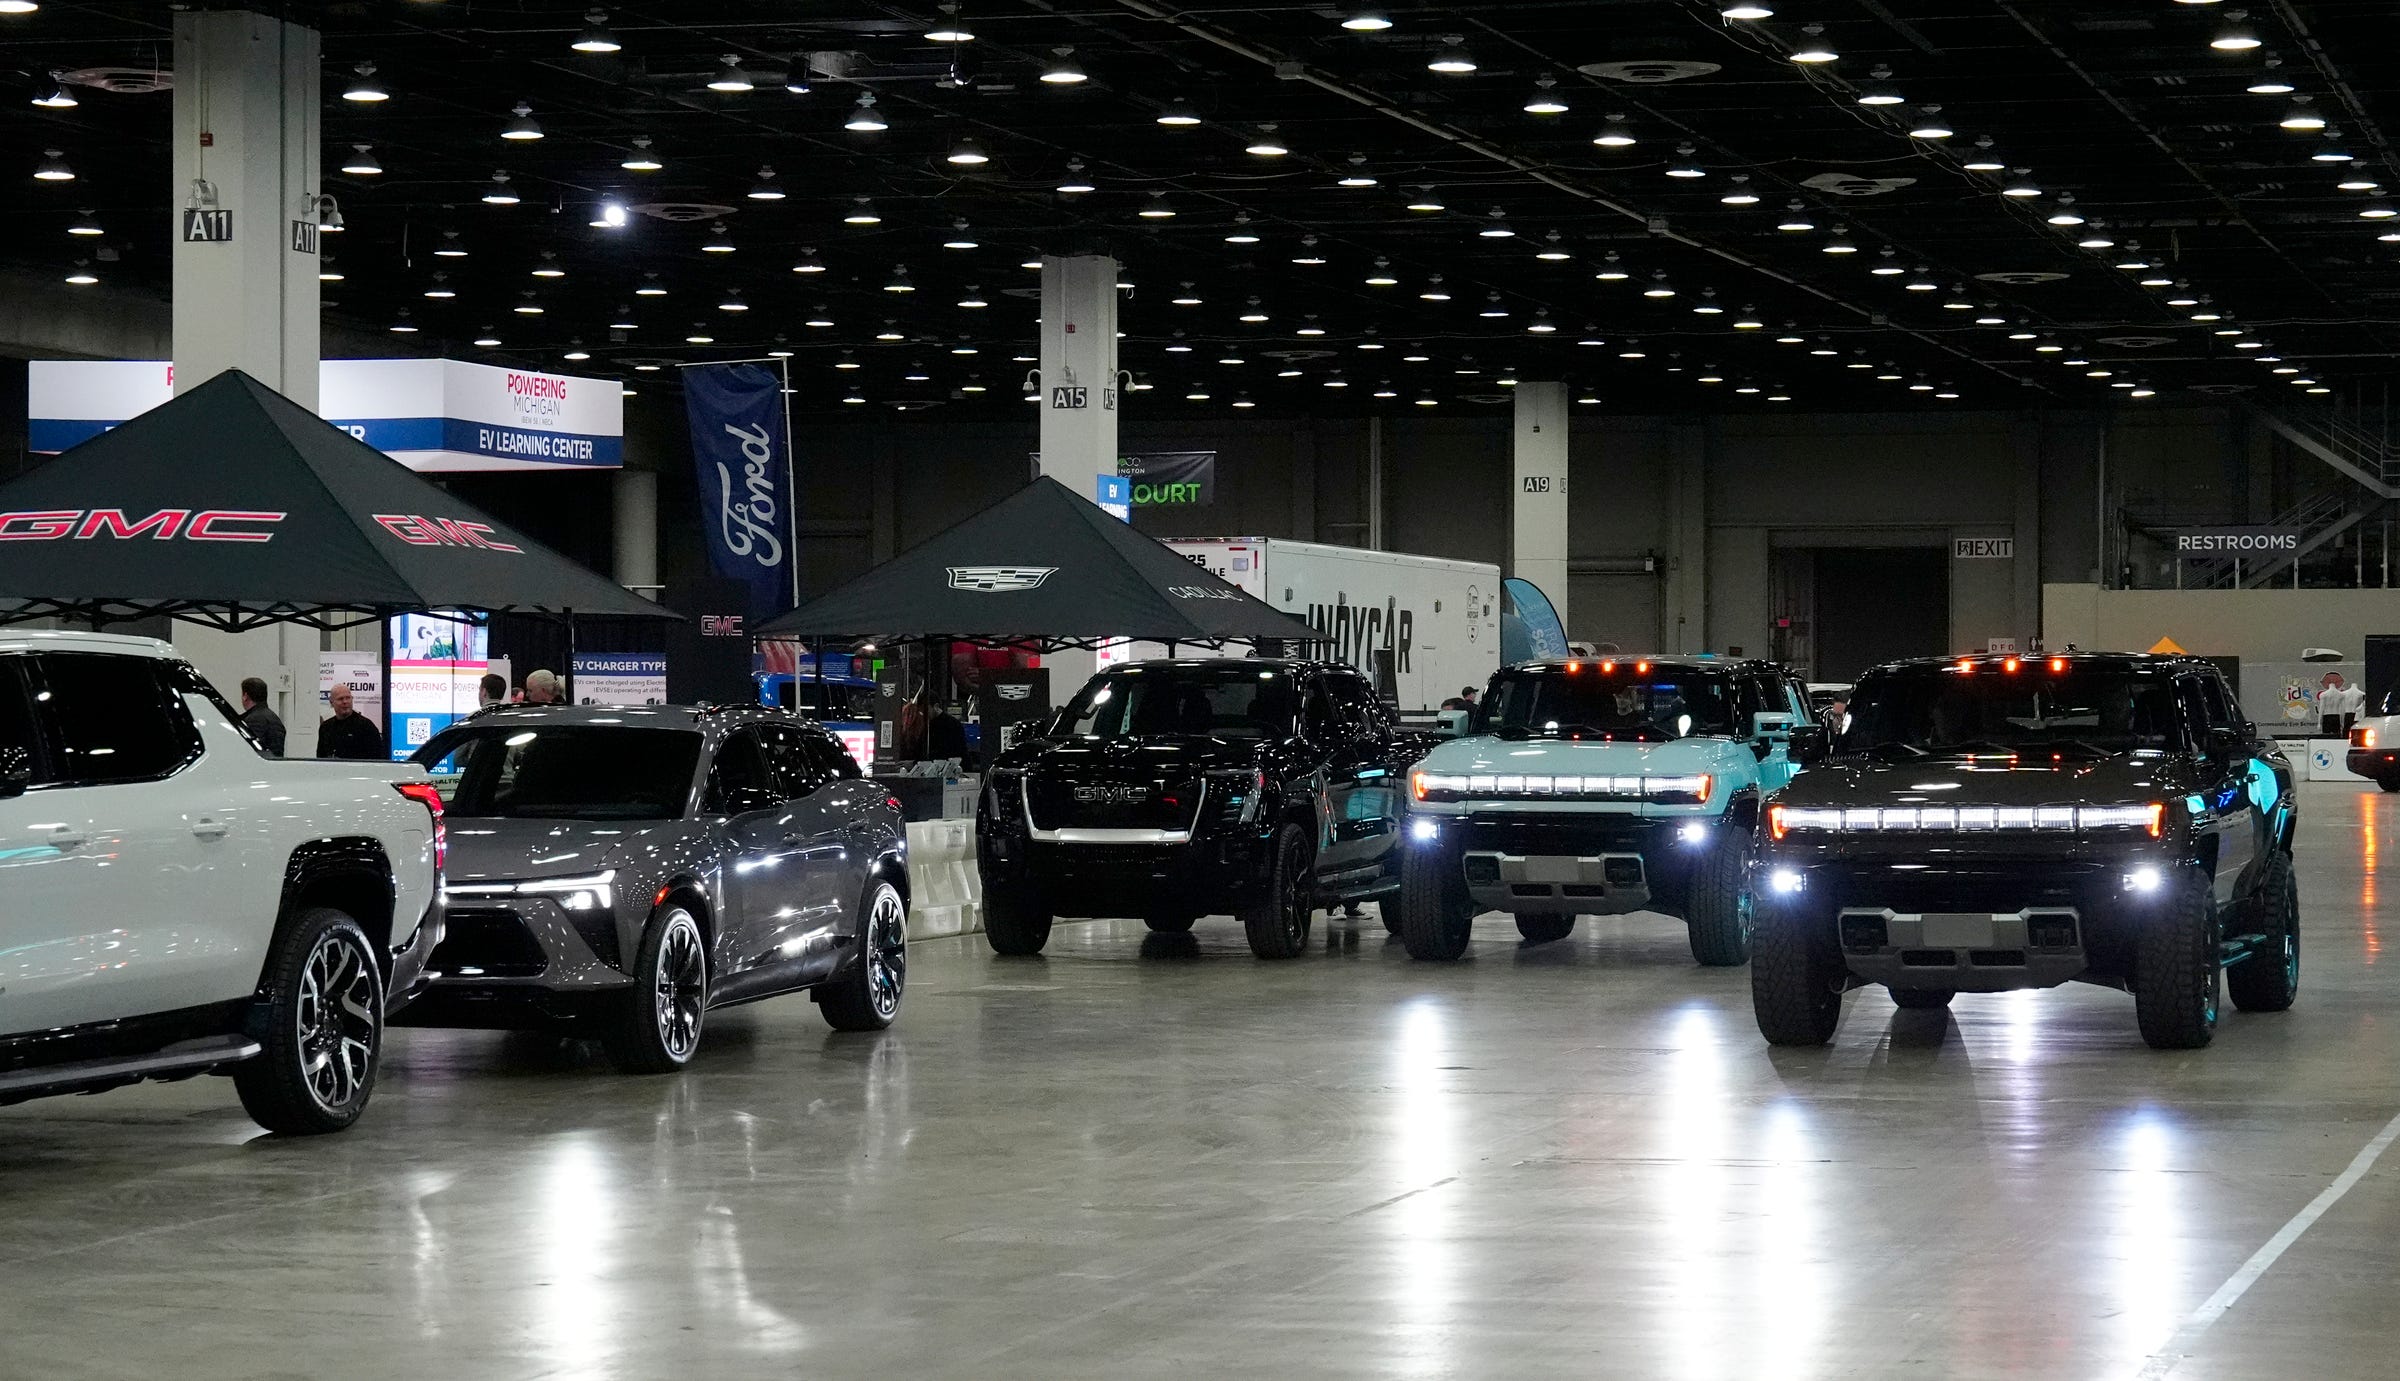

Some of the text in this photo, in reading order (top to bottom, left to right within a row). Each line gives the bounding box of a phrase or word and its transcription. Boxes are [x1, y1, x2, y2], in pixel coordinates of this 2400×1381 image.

[189, 211, 227, 240] A11
[295, 222, 314, 252] A11
[507, 373, 566, 400] POWERING
[513, 396, 560, 416] MICHIGAN
[1054, 388, 1087, 408] A15
[479, 429, 593, 460] EV LEARNING CENTER
[716, 422, 783, 567] Ford
[1109, 484, 1118, 498] EV
[1129, 482, 1201, 504] OURT
[1525, 477, 1549, 492] A19
[0, 509, 287, 542] GMC
[372, 514, 525, 554] GMC
[1974, 540, 2011, 556] EXIT
[2178, 535, 2297, 550] RESTROOMS
[1168, 586, 1243, 602] CADILLAC
[701, 615, 743, 636] GMC
[1306, 603, 1412, 674] INDYCAR
[573, 661, 667, 671] EV CHARGER TYPE
[391, 682, 447, 692] POWERING
[1074, 786, 1147, 801] GMC
